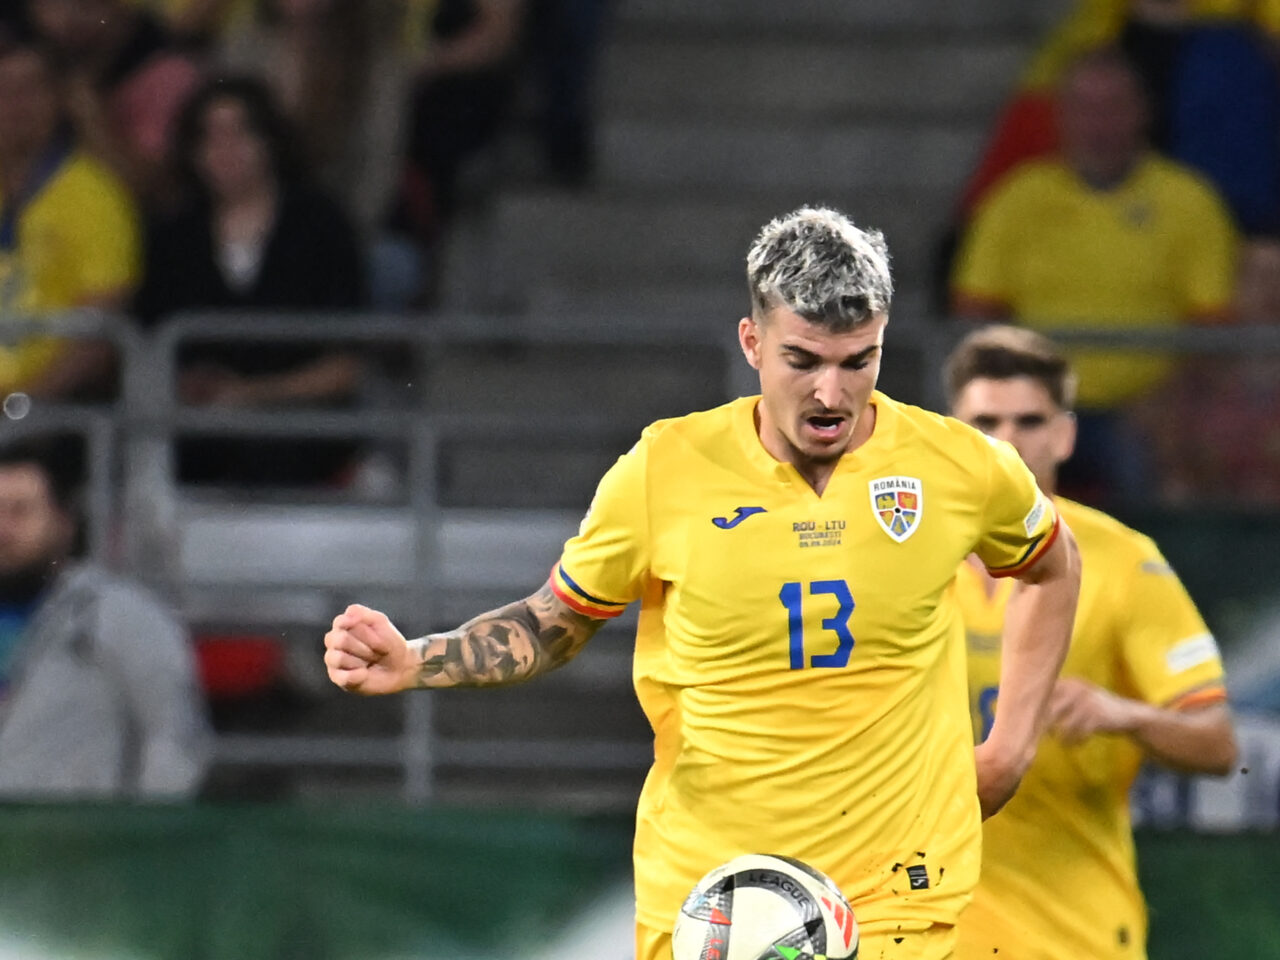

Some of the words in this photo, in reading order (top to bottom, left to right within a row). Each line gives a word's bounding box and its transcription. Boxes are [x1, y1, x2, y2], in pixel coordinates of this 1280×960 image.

[792, 521, 816, 532] ROU
[825, 520, 847, 530] LTU
[778, 579, 856, 670] 13
[748, 872, 811, 908] LEAGUE
